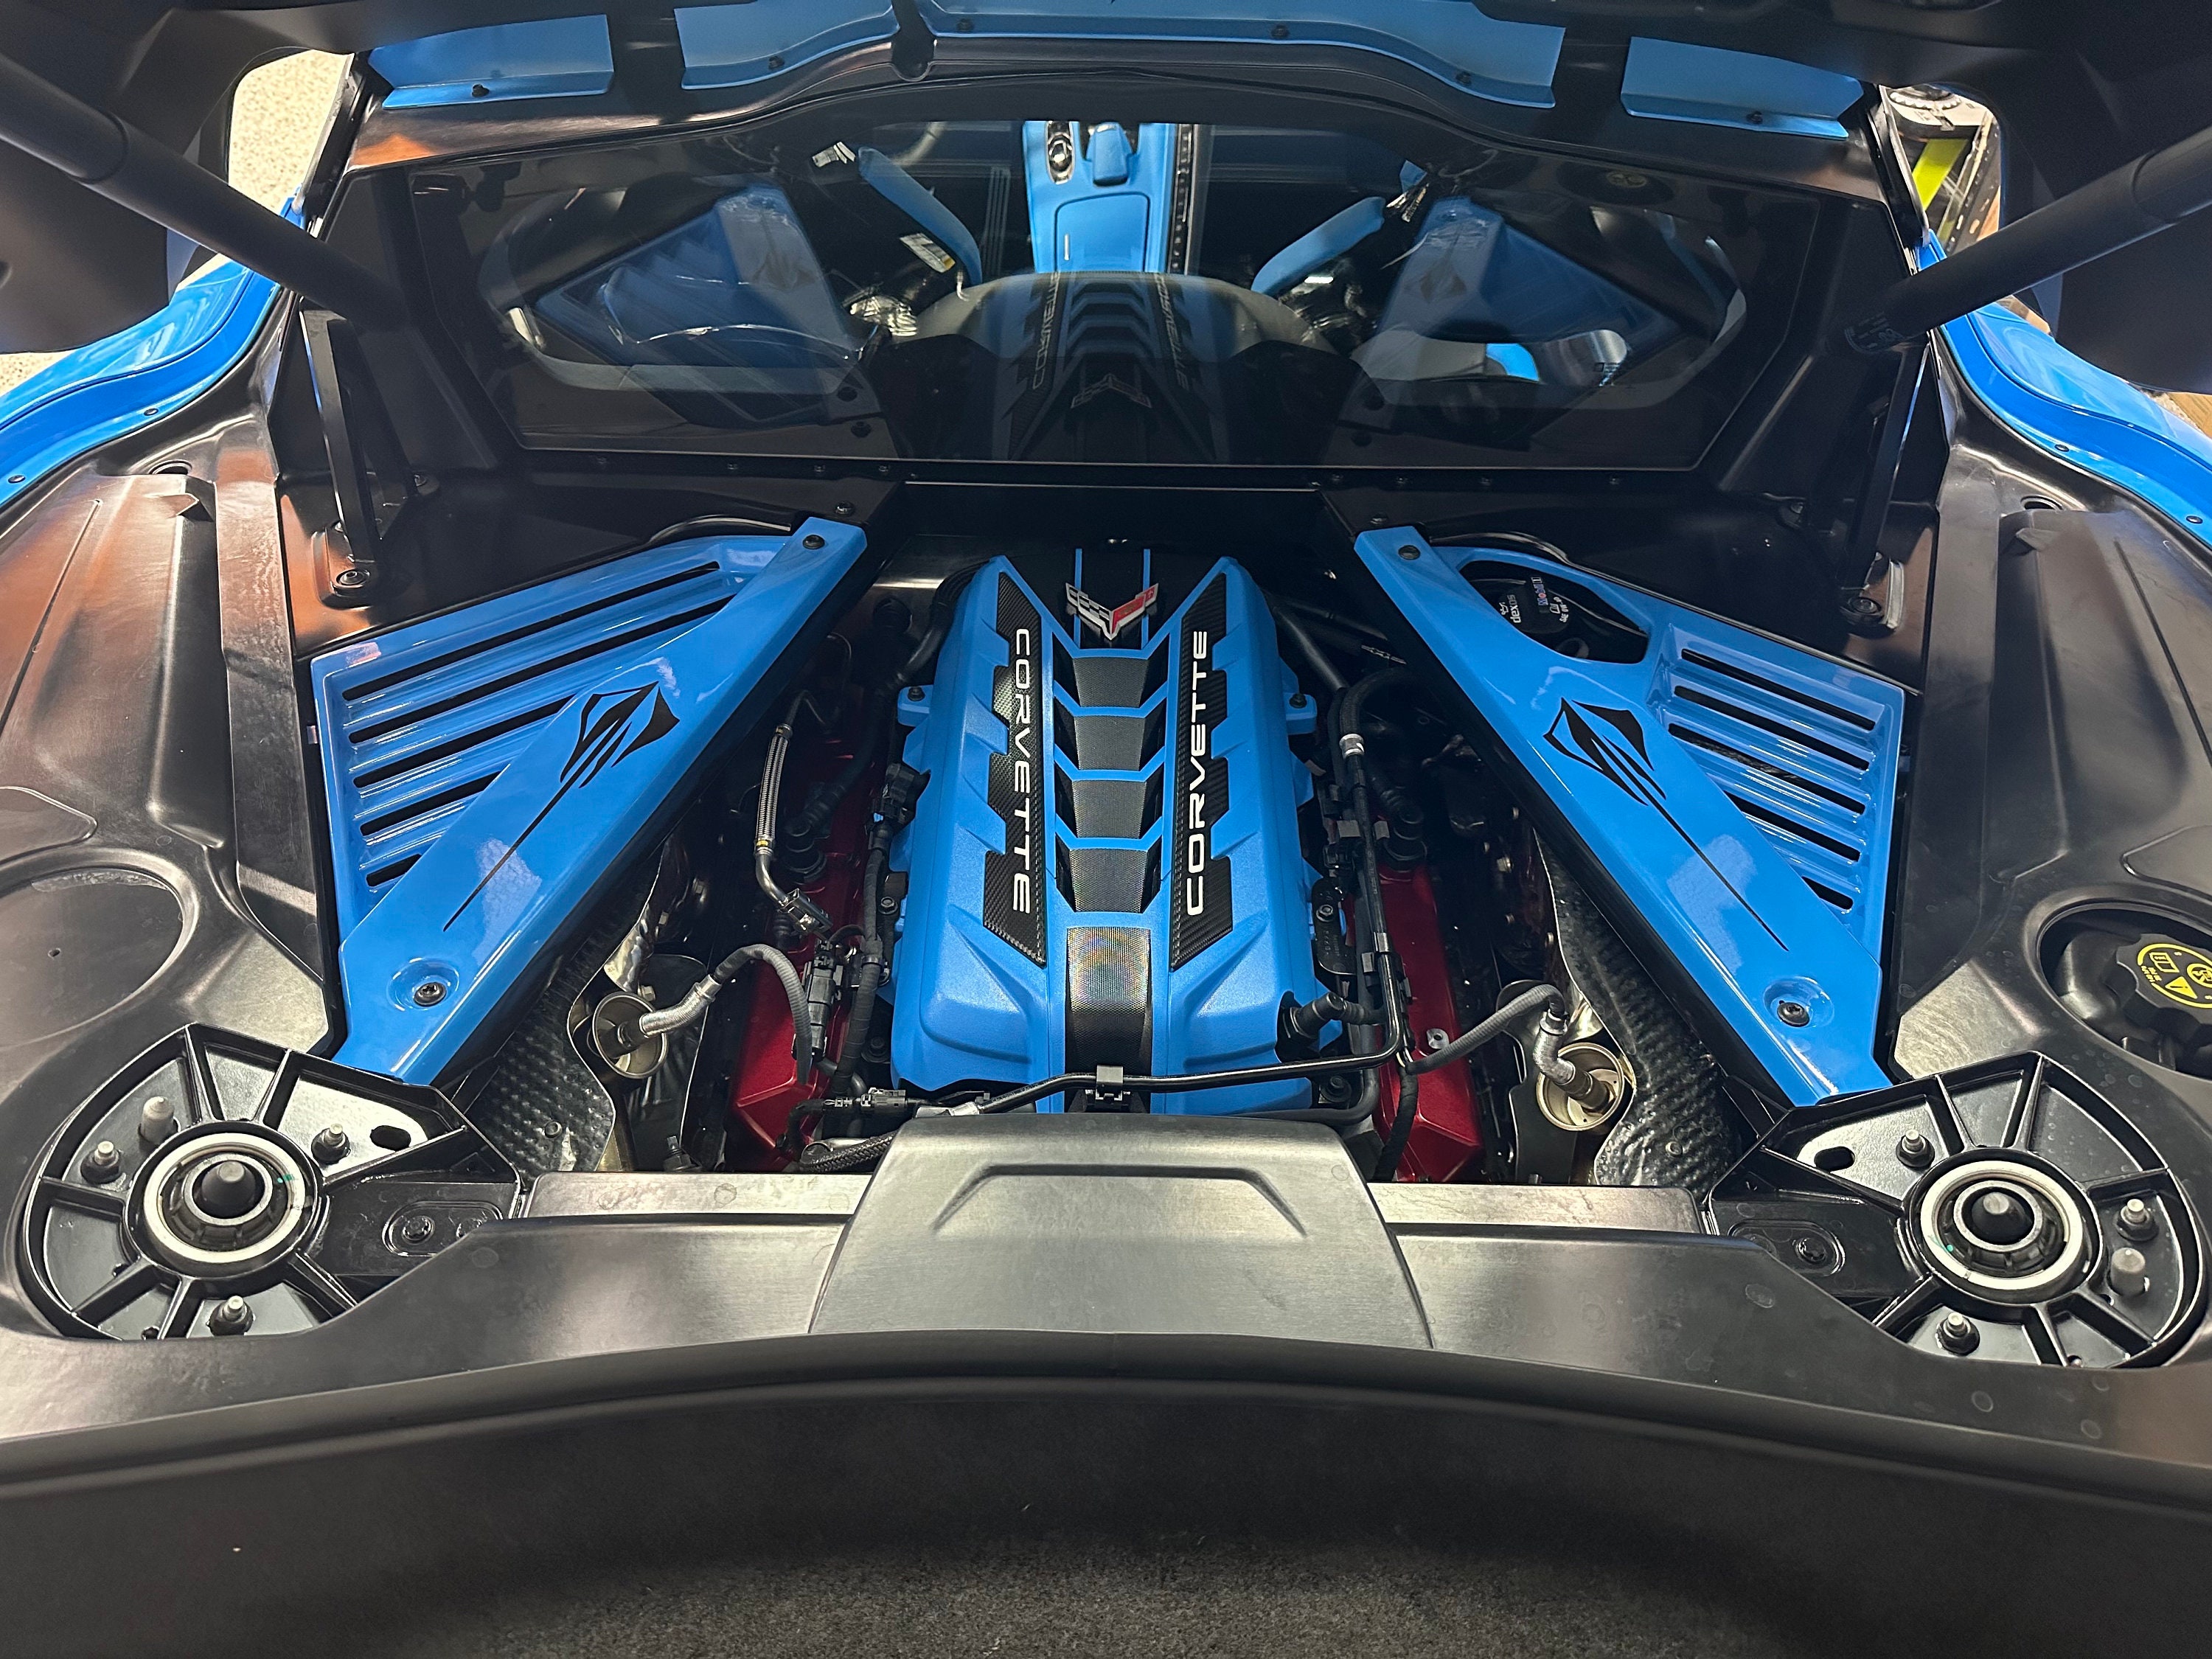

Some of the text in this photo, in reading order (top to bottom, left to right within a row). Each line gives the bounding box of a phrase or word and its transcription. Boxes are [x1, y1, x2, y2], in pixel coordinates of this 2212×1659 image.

[1506, 594, 1521, 623] dexos
[1012, 627, 1032, 914] CORVETTE
[1186, 630, 1208, 916] CORVETTE
